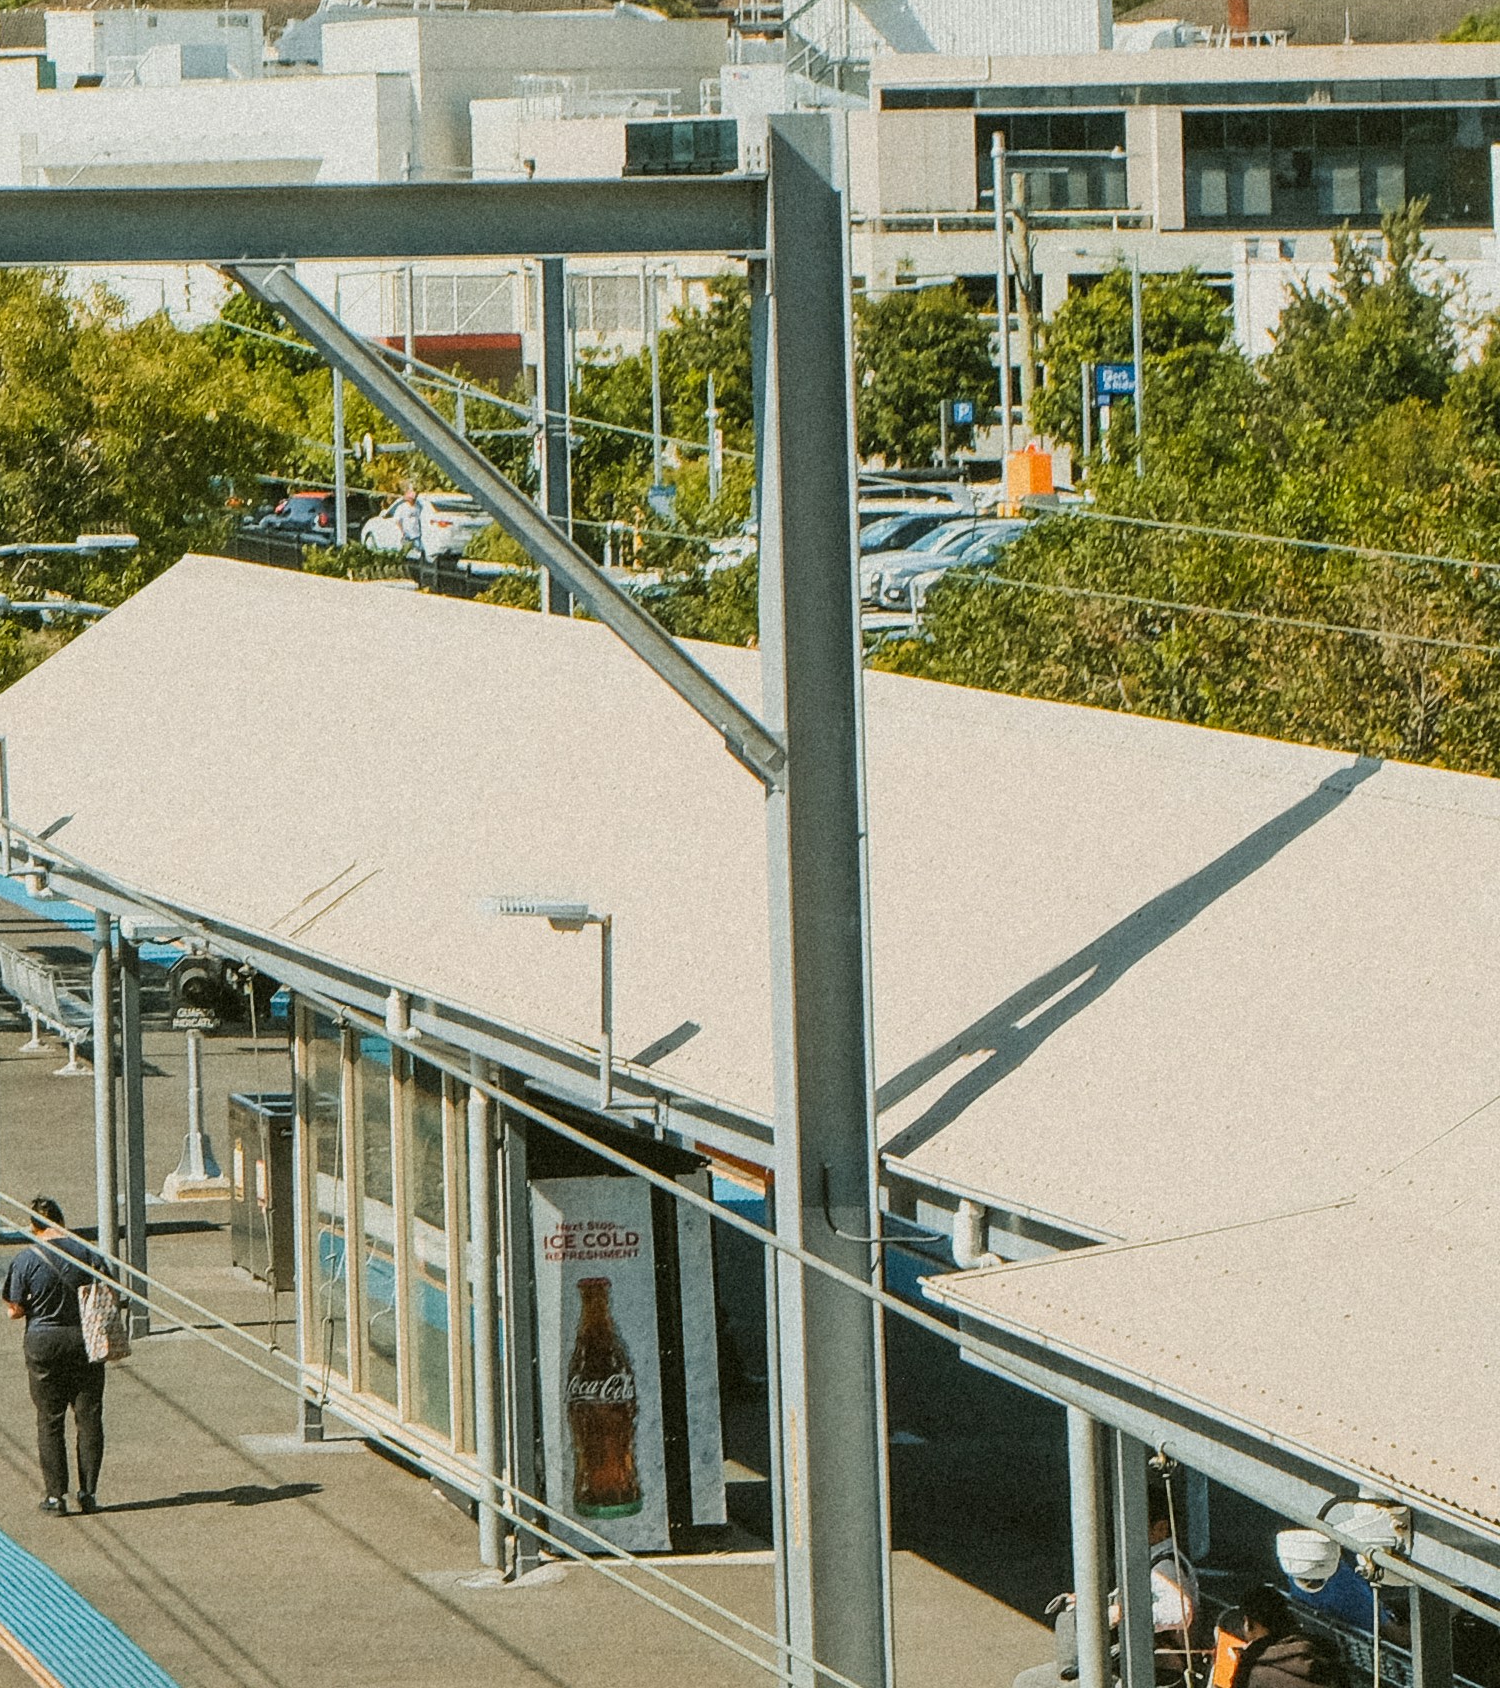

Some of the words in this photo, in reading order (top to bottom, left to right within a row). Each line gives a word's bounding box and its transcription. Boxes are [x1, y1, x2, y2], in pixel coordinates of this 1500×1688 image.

[958, 403, 970, 421] P
[555, 1222, 583, 1232] Next
[543, 1234, 576, 1250] ICE
[582, 1232, 639, 1248] COLD
[545, 1248, 639, 1261] REFRESHMENT
